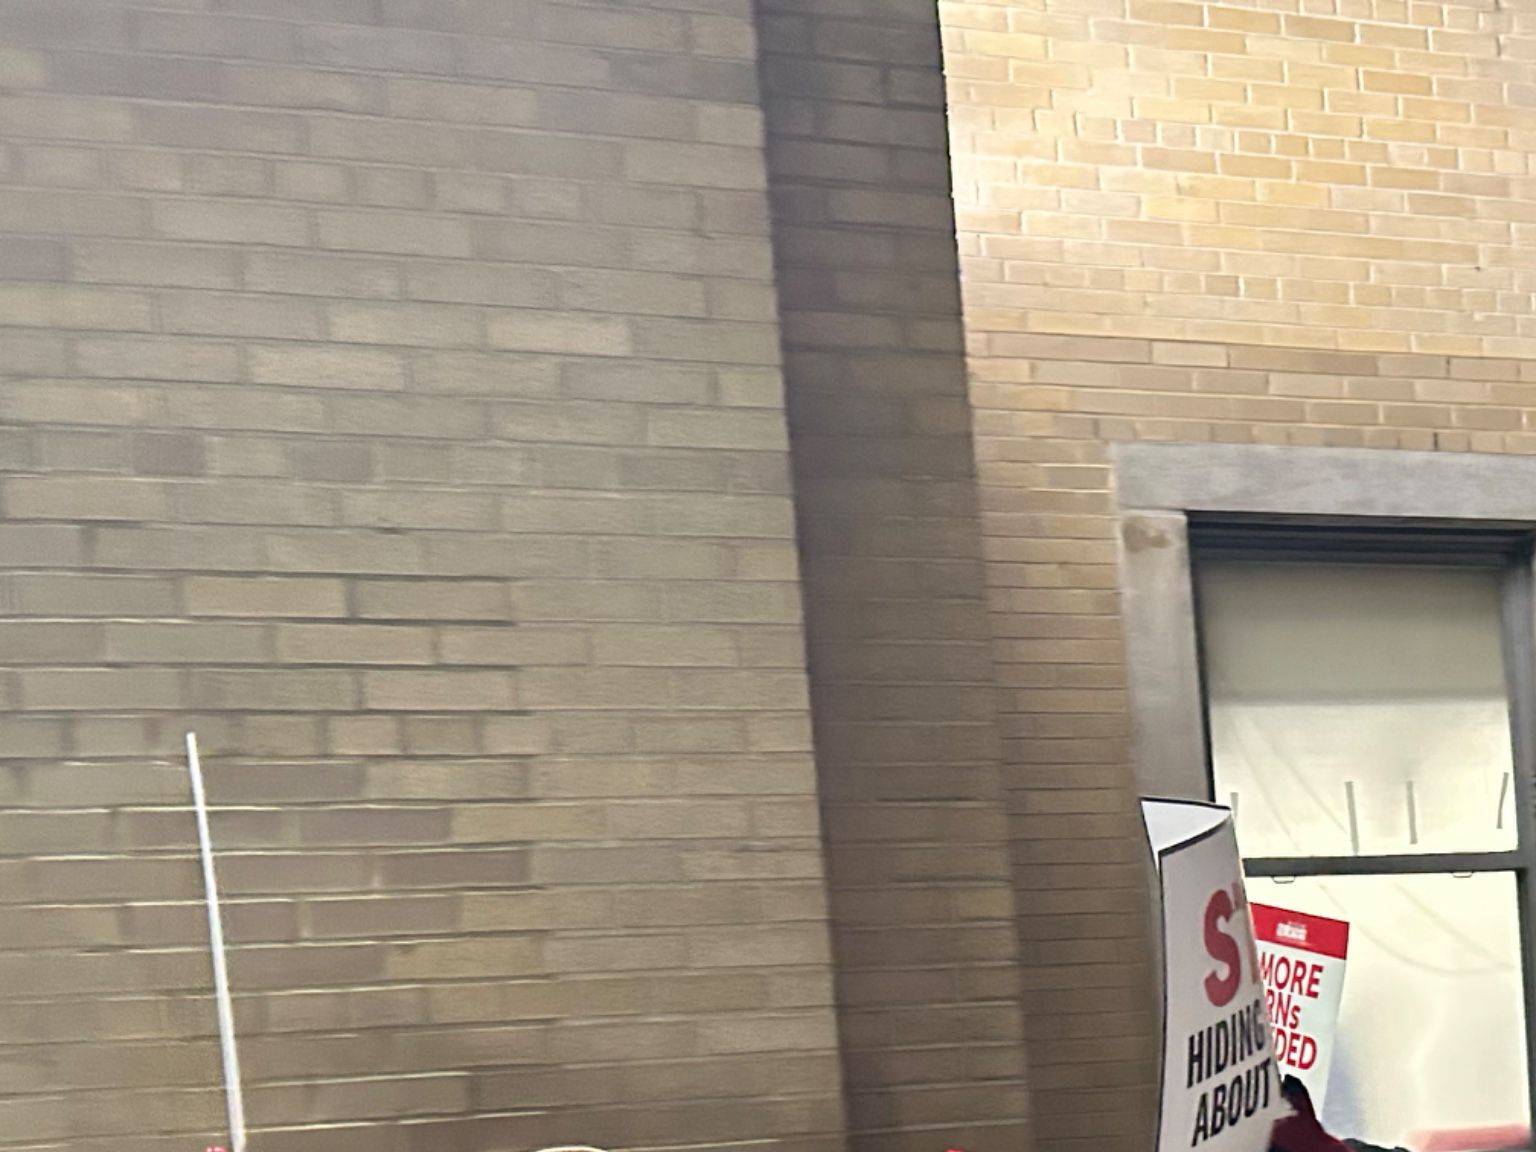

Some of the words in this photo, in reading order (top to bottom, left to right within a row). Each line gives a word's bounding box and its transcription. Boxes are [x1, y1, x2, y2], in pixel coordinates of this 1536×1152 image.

[1260, 952, 1324, 998] MORE
[1187, 999, 1266, 1089] HIDING
[1191, 1057, 1274, 1147] ABOUT
